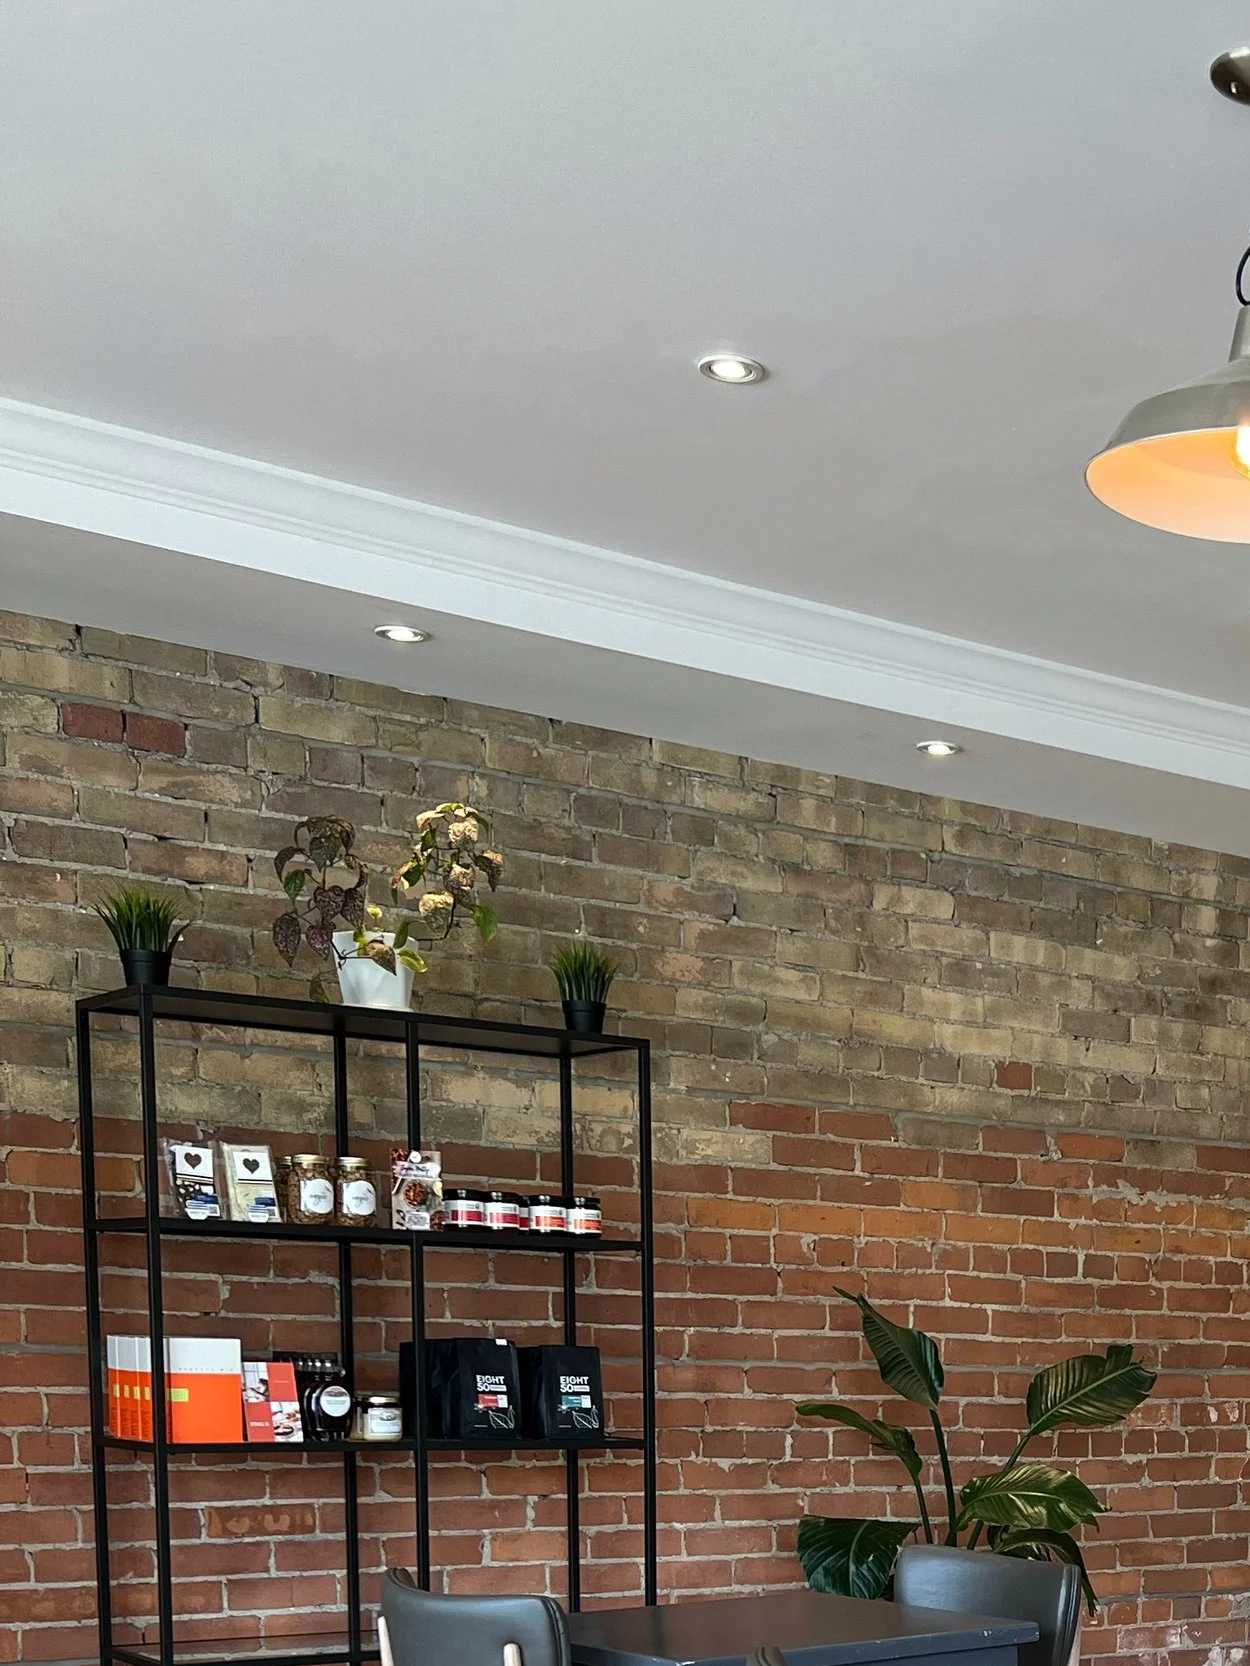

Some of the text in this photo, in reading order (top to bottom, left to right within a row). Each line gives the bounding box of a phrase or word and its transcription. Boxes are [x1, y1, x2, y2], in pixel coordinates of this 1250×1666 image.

[476, 1375, 505, 1384] EIGHT
[560, 1376, 589, 1385] EIGHT
[477, 1383, 490, 1392] 50
[560, 1384, 573, 1393] 50
